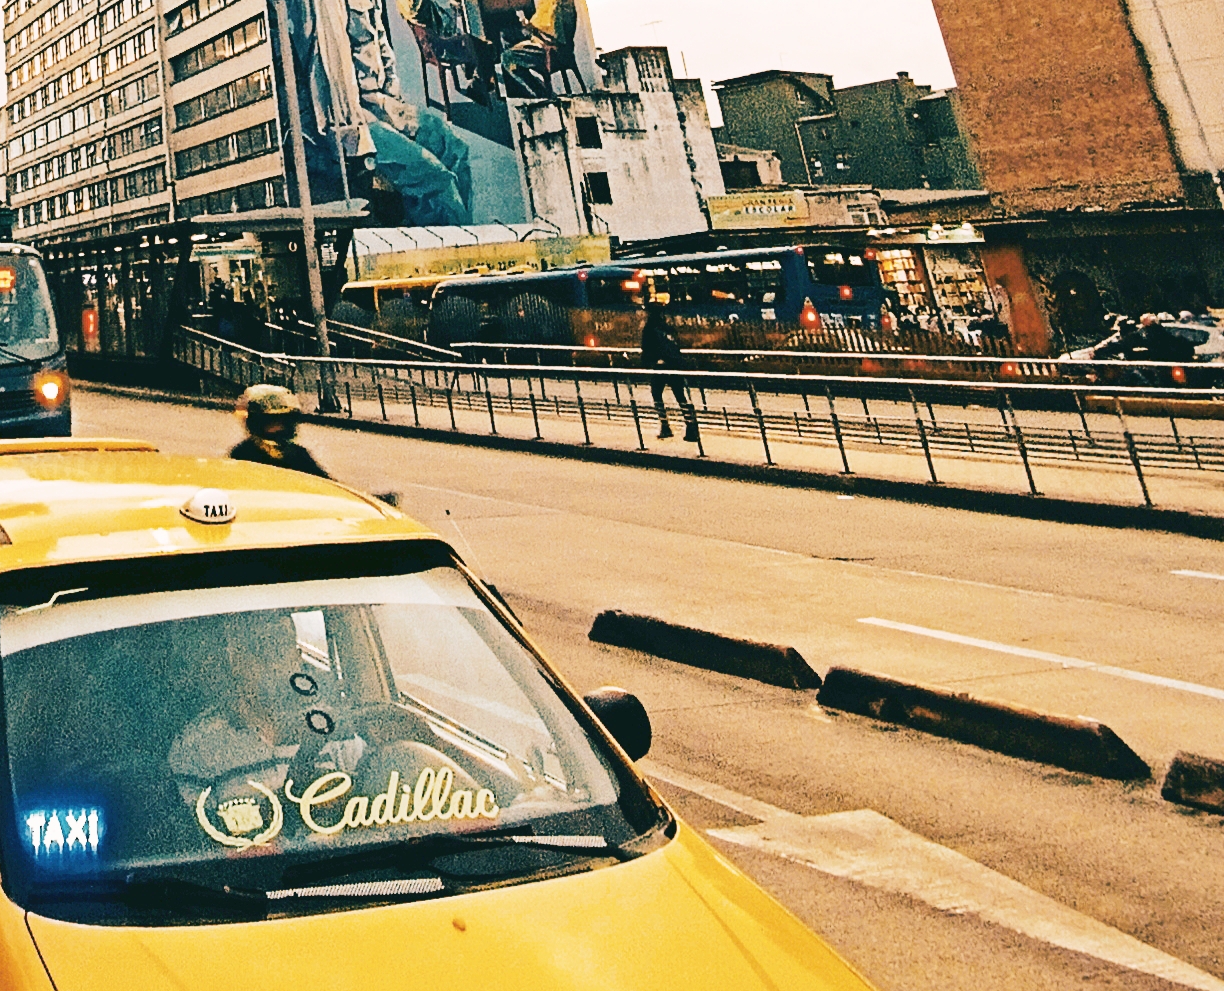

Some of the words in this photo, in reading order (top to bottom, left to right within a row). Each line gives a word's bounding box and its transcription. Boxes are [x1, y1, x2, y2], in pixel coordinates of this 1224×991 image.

[201, 504, 228, 518] TAXI
[284, 766, 500, 835] Cadillac
[26, 808, 99, 857] TAXI
